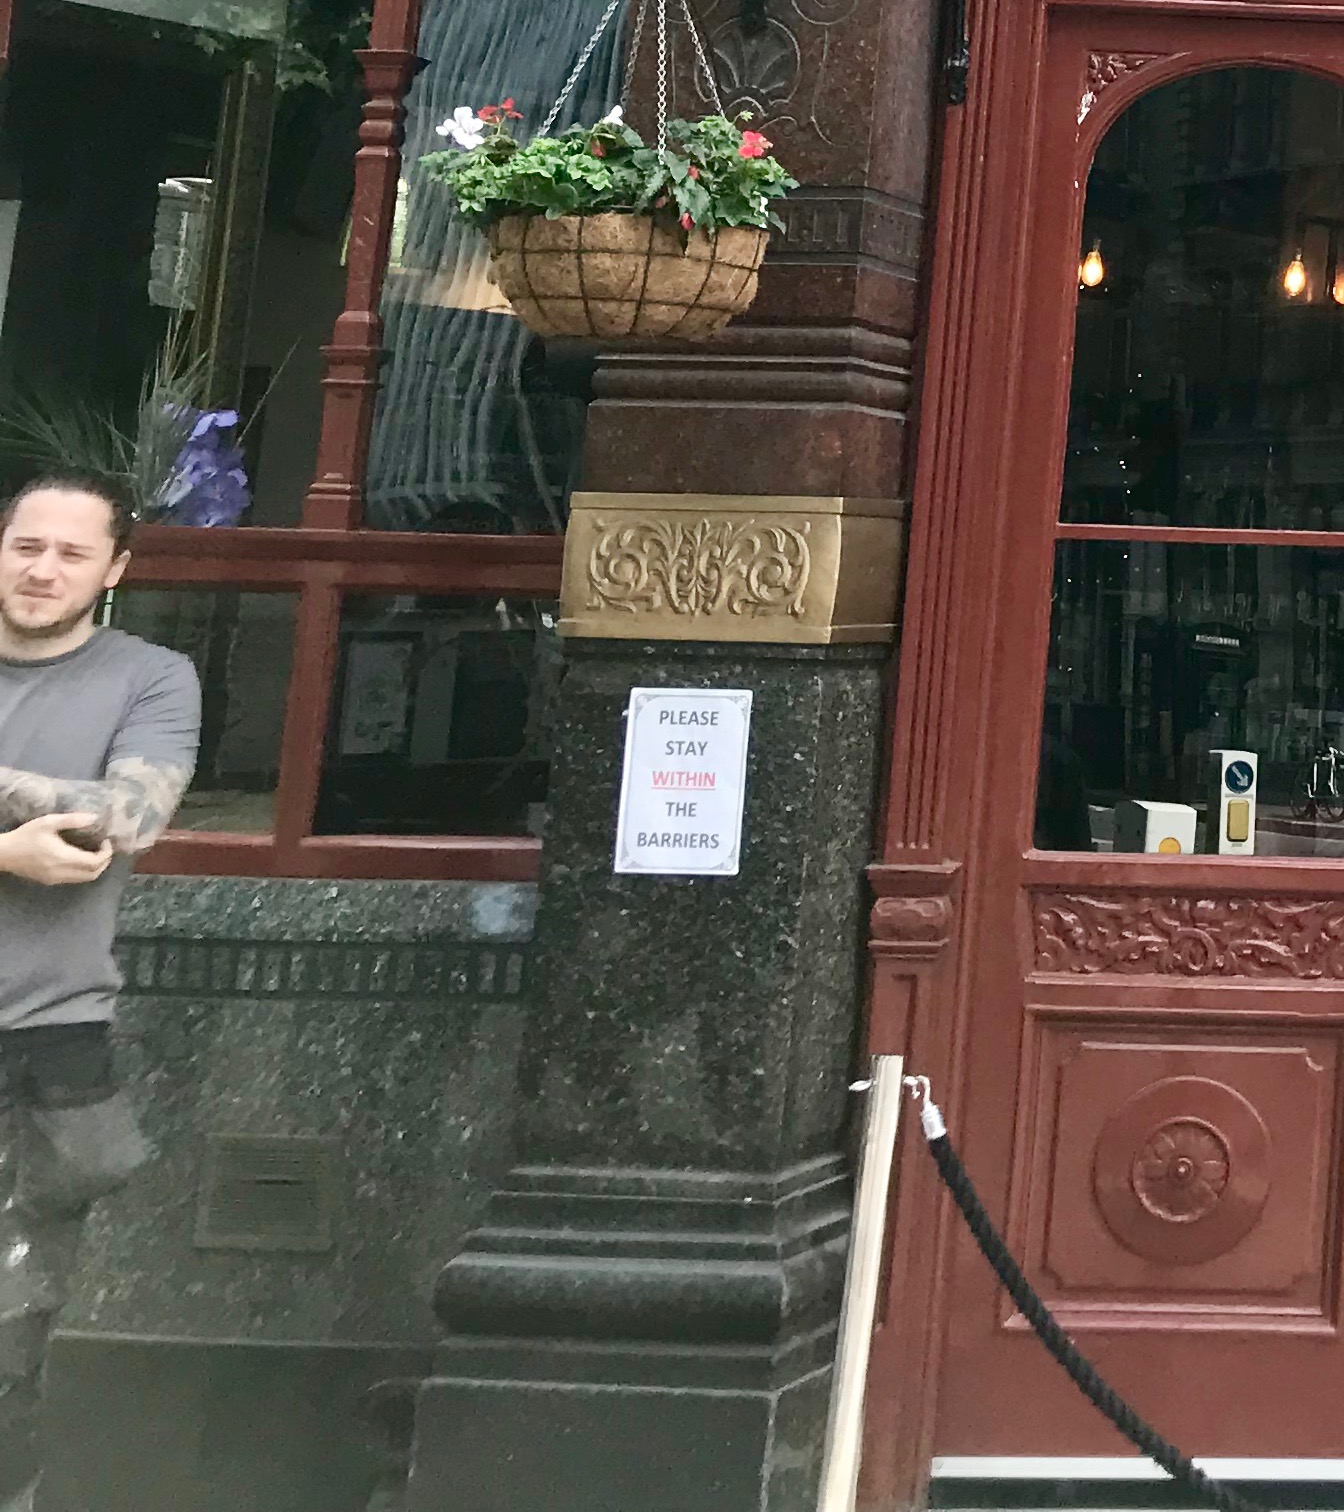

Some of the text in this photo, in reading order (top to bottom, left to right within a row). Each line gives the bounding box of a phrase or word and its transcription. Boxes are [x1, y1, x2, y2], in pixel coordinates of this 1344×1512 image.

[658, 710, 719, 726] PLEASE
[665, 740, 708, 756] STAY
[652, 770, 716, 788] WITHIN
[665, 801, 697, 817] THE
[636, 832, 720, 849] BARRIERS
